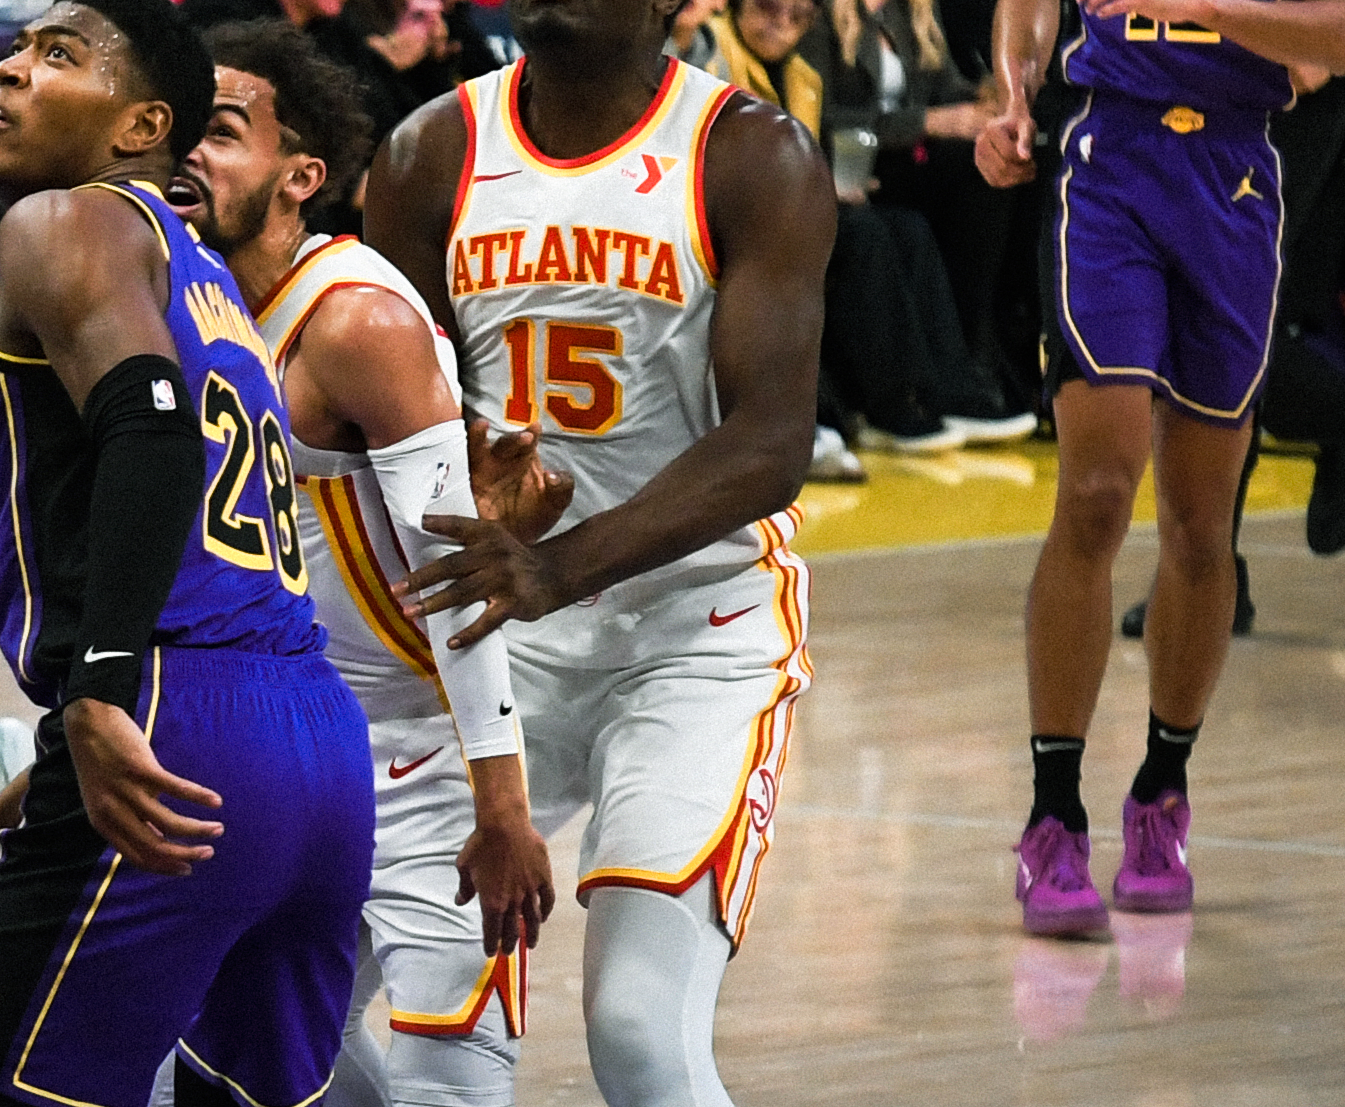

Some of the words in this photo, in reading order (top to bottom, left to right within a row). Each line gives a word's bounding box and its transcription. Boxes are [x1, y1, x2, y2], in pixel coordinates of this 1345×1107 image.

[452, 224, 685, 307] ATLANTA
[503, 317, 624, 437] 15
[201, 369, 309, 596] 28
